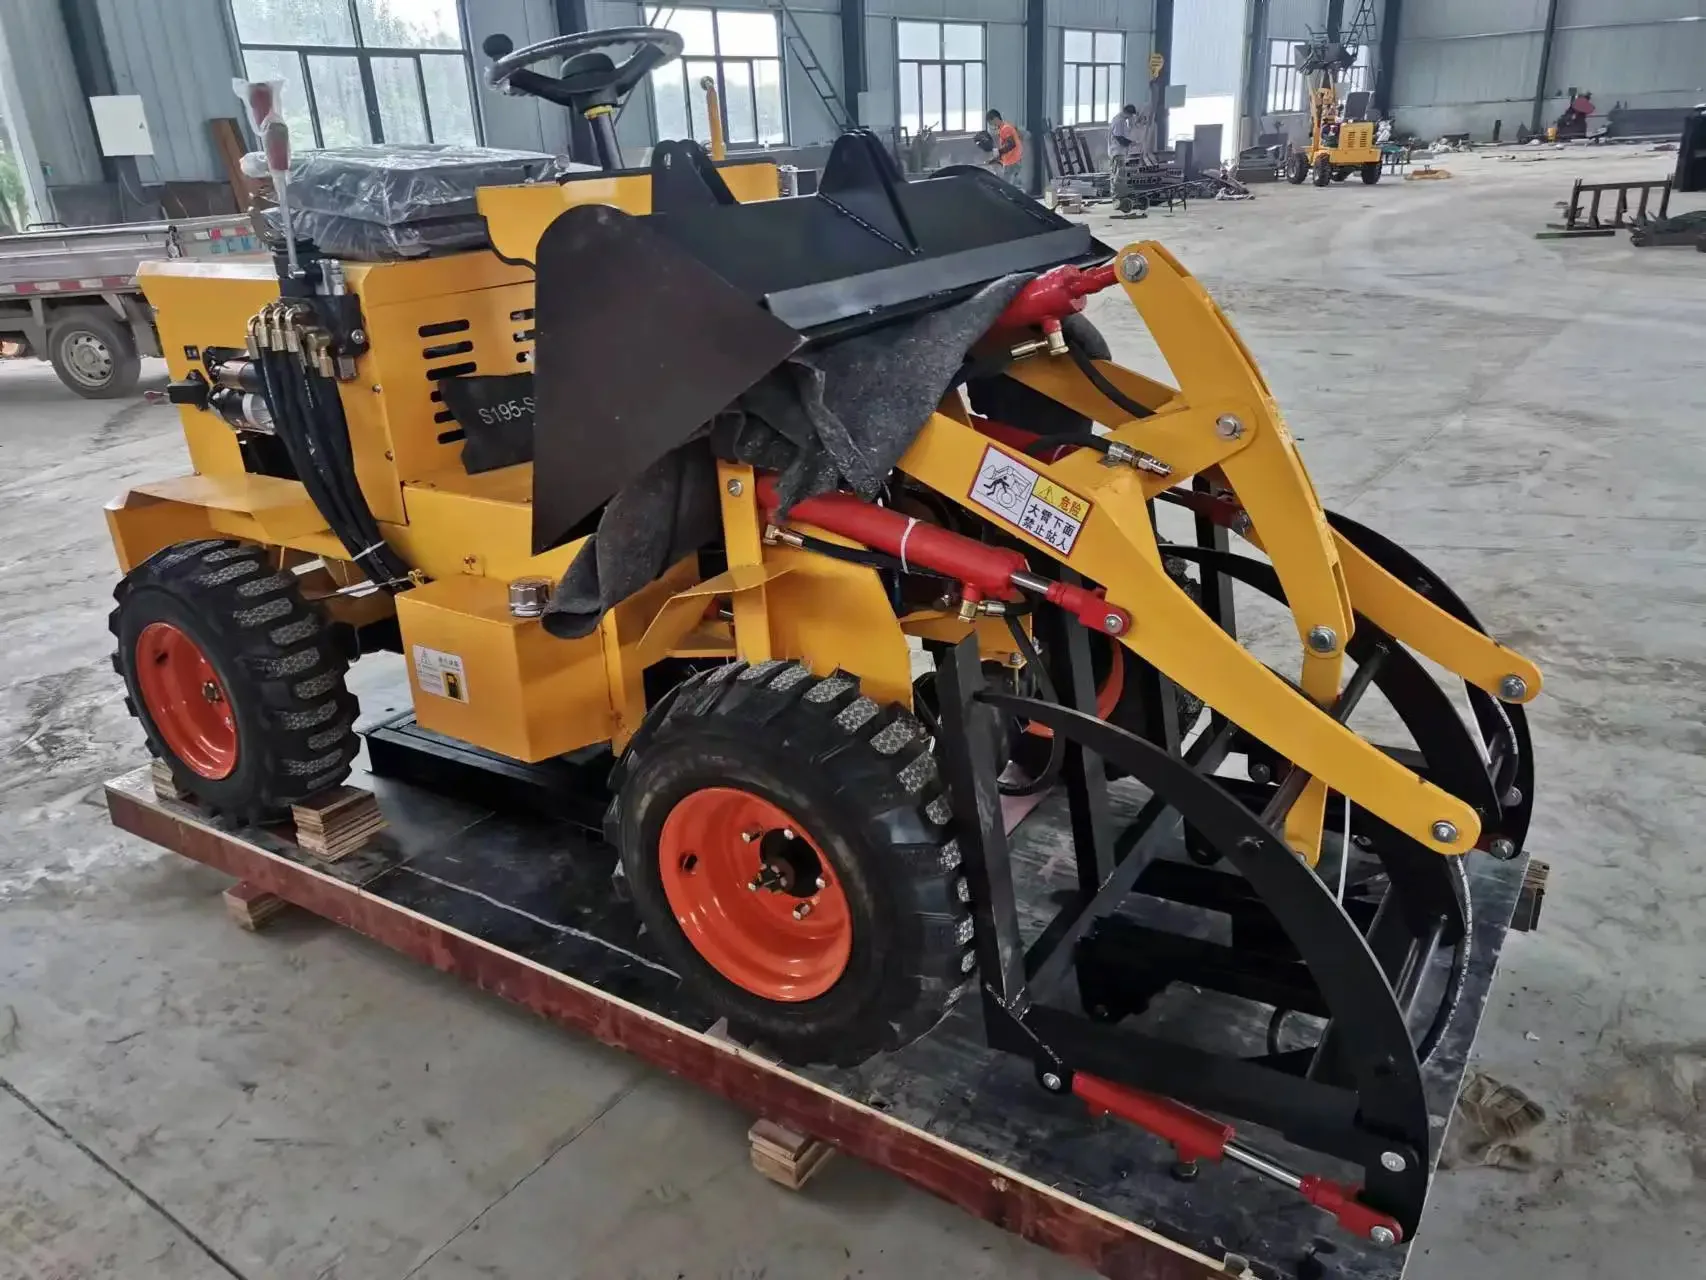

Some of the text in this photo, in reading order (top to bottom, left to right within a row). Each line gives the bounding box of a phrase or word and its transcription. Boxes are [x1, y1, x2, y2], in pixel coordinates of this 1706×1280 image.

[1028, 503, 1075, 537] 大臂下面
[1058, 496, 1082, 517] 危险
[1022, 516, 1066, 550] 禁止站人
